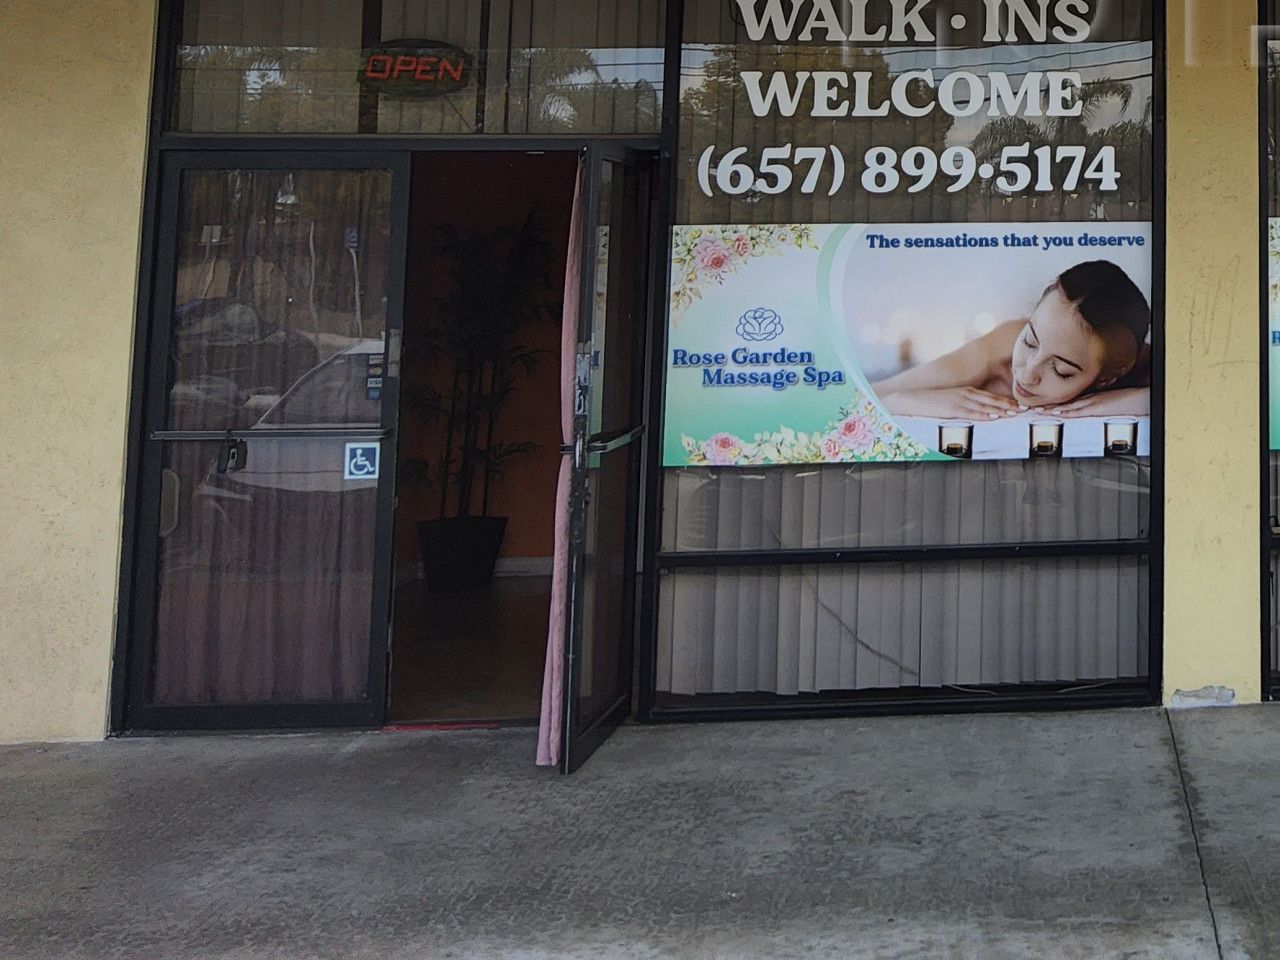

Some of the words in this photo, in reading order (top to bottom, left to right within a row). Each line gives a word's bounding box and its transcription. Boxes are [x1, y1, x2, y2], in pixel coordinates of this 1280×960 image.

[365, 53, 465, 81] OPEN
[742, 71, 1084, 117] WELCOME
[697, 145, 845, 197] (657)
[866, 234, 900, 248] The
[904, 234, 999, 248] sensations
[1003, 234, 1040, 247] that
[1042, 236, 1074, 250] you
[1077, 233, 1145, 247] deserve
[672, 348, 726, 367] Rose
[731, 347, 814, 366] Garden
[702, 367, 798, 389] Massage
[803, 366, 845, 388] Spa
